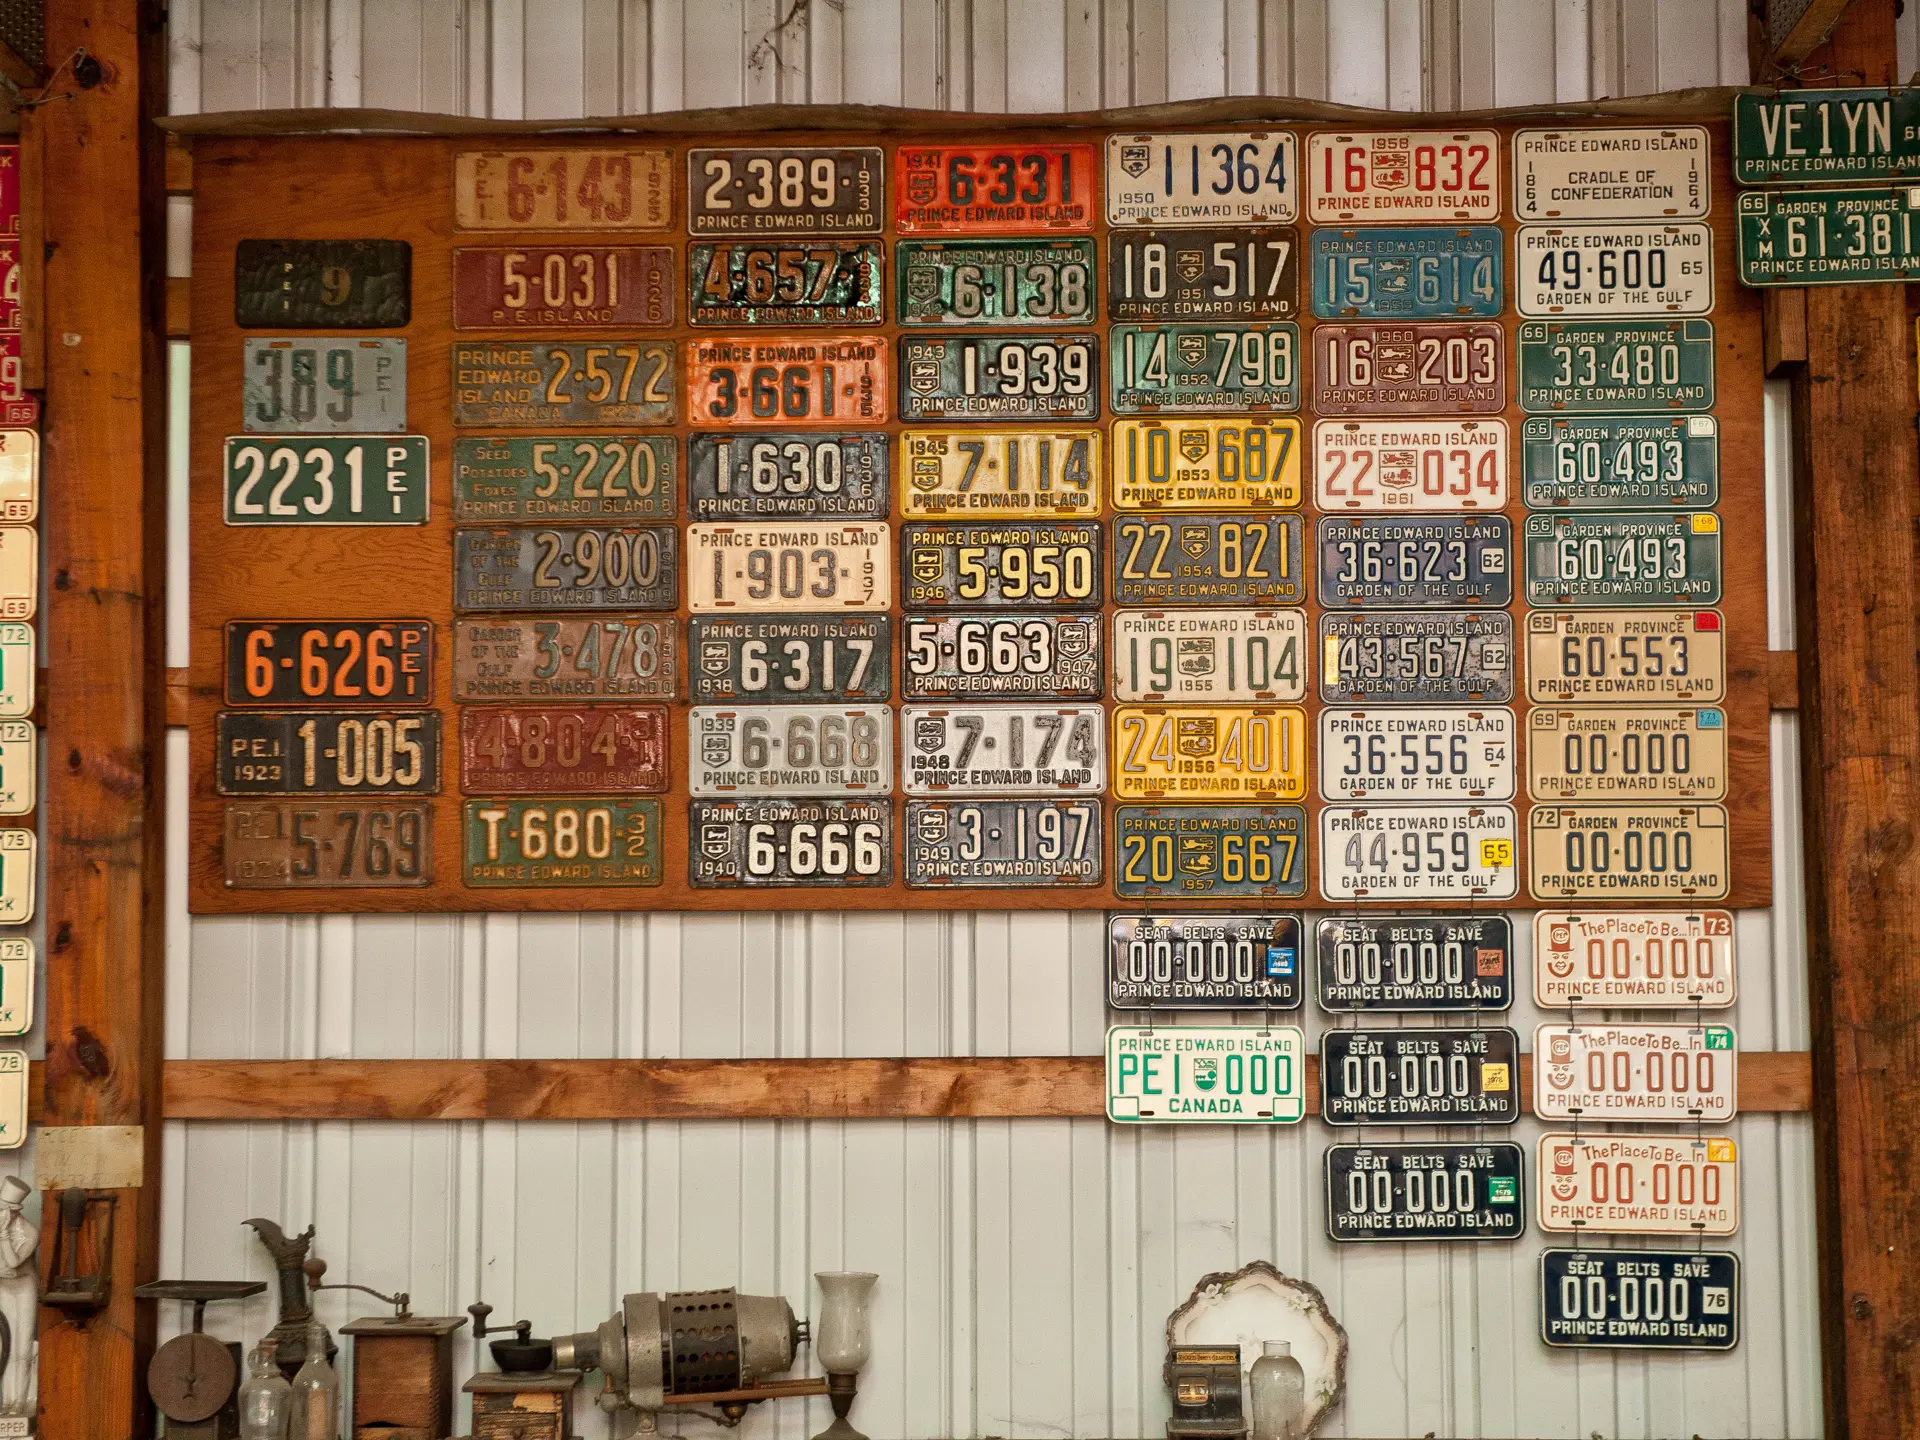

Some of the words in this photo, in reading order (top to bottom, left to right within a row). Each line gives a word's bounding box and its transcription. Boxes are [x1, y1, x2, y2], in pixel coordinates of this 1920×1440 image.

[1759, 102, 1891, 155] VE1YN
[1372, 138, 1409, 149] 1958
[1525, 140, 1576, 152] PRINCE
[1582, 140, 1640, 151] EDWARD
[1645, 138, 1698, 150] ISLAND
[906, 156, 942, 168] 1941
[1746, 160, 1799, 171] PRINCE
[1805, 158, 1866, 170] EDWARD
[1165, 143, 1287, 196] 11364
[1325, 147, 1366, 193] 16
[1415, 146, 1489, 192] 832
[1568, 172, 1628, 184] CRADLE
[1636, 171, 1655, 183] OF
[1118, 193, 1155, 204] 1950
[1552, 186, 1673, 200] CONFEDERATION
[1318, 197, 1370, 209] PRINCE
[1375, 196, 1434, 208] EDWARD
[1438, 195, 1489, 208] ISLAND
[1744, 198, 1763, 208] 66
[1777, 203, 1827, 214] GARDEN
[1838, 200, 1899, 212] PROVINCE
[1118, 206, 1168, 218] PRINCE
[1173, 205, 1231, 217] EDWARD
[1237, 204, 1287, 216] ISLAND
[698, 216, 749, 229] PRINCE
[755, 215, 814, 228] EDWARD
[821, 215, 873, 227] ISLAND
[1125, 243, 1166, 298] 18
[1214, 243, 1290, 296] 517
[1682, 262, 1702, 275] 65
[1327, 258, 1370, 304] 15
[1417, 257, 1493, 303] 614
[321, 268, 351, 306] 9
[1177, 289, 1206, 299] 1951
[1537, 293, 1591, 305] GARDEN
[1598, 293, 1616, 304] OF
[1623, 292, 1649, 304] THE
[1656, 291, 1693, 303] GULF
[1376, 331, 1413, 342] 1960
[1524, 328, 1543, 339] 66
[1557, 332, 1604, 343] GARDEN
[1615, 331, 1675, 342] PROVINCE
[459, 351, 532, 365] PRINCE
[907, 347, 944, 359] 1943
[1216, 332, 1290, 386] 798
[1126, 334, 1167, 387] 14
[1329, 340, 1371, 385] 16
[1419, 339, 1495, 385] 203
[459, 370, 541, 384] EDWARD
[1175, 374, 1208, 385] 1952
[257, 349, 354, 422] 389
[459, 390, 531, 403] ISLAND
[913, 399, 964, 411] PRINCE
[970, 399, 1028, 411] EDWARD
[1034, 398, 1086, 410] ISLAND
[1528, 424, 1547, 435] 66
[1325, 434, 1376, 446] PRINCE
[1382, 434, 1441, 446] EDWARD
[1446, 433, 1497, 445] ISLAND
[911, 442, 948, 455] 1945
[1218, 428, 1292, 482] 687
[1128, 429, 1170, 483] 10
[1177, 470, 1209, 481] 1953
[1326, 450, 1373, 495] 22
[1423, 450, 1497, 495] 034
[235, 447, 362, 514] 2231
[387, 448, 407, 513] PEI
[1122, 488, 1173, 500] PRINCE
[1178, 488, 1237, 500] EDWARD
[1242, 488, 1292, 500] ISLAND
[1382, 494, 1414, 505] 1961
[9, 506, 28, 516] 69
[698, 500, 751, 512] PRINCE
[756, 499, 816, 512] EDWARD
[823, 498, 875, 512] ISLAND
[1531, 521, 1550, 532] 66
[913, 533, 964, 545] PRINCE
[970, 532, 1029, 544] EDWARD
[1035, 532, 1088, 544] ISLAND
[1123, 525, 1172, 578] 22
[1219, 523, 1288, 579] 821
[1483, 554, 1503, 567] 62
[911, 587, 944, 599] 1946
[1337, 585, 1390, 597] GARDEN
[1398, 585, 1416, 597] OF
[1424, 584, 1448, 596] THE
[1457, 584, 1492, 596] GULF
[7, 604, 26, 614] 69
[1124, 620, 1175, 632] PRINCE
[1180, 619, 1238, 631] EDWARD
[1243, 619, 1294, 631] ISLAND
[1532, 617, 1552, 629] 69
[400, 631, 420, 695] PEI
[1057, 661, 1094, 673] 1947
[1130, 637, 1172, 692] 19
[1228, 636, 1298, 690] 104
[697, 680, 733, 692] 1938
[1179, 680, 1212, 691] 1955
[701, 719, 735, 731] 1939
[1535, 714, 1555, 726] 69
[7, 727, 26, 738] 72
[1124, 718, 1174, 771] 24
[1220, 717, 1288, 771] 401
[1485, 749, 1505, 762] 64
[911, 756, 949, 769] 1948
[234, 766, 280, 780] 1923
[703, 772, 756, 784] PRINCE
[760, 772, 820, 784] EDWARD
[826, 771, 879, 784] ISLAND
[1537, 812, 1556, 824] 72
[1569, 817, 1618, 829] GARDEN
[1628, 817, 1688, 828] PROVINCE
[8, 834, 24, 846] 75
[915, 848, 950, 860] 1949
[1484, 845, 1508, 858] 65
[1125, 837, 1172, 881] 20
[1222, 836, 1298, 881] 667
[699, 863, 735, 875] 1940
[1181, 880, 1213, 890] 1957
[1708, 918, 1730, 934] 73
[1119, 1039, 1171, 1051] PRINCE
[1176, 1039, 1232, 1051] EDWARD
[1240, 1040, 1291, 1051] ISLAND
[1226, 1055, 1292, 1094] 000
[1169, 1099, 1242, 1113] CANADA
[1333, 1100, 1386, 1113] PRINCE
[1390, 1100, 1451, 1112] EDWARD
[1455, 1099, 1507, 1112] ISLAND
[1569, 1262, 1602, 1275] SEAT
[1618, 1263, 1659, 1276] BELTS
[1674, 1263, 1709, 1277] SAVE
[1708, 1294, 1725, 1307] 76
[1552, 1321, 1605, 1335] PRINCE
[1609, 1322, 1669, 1336] EDWARD
[1674, 1323, 1727, 1337] ISLAND
